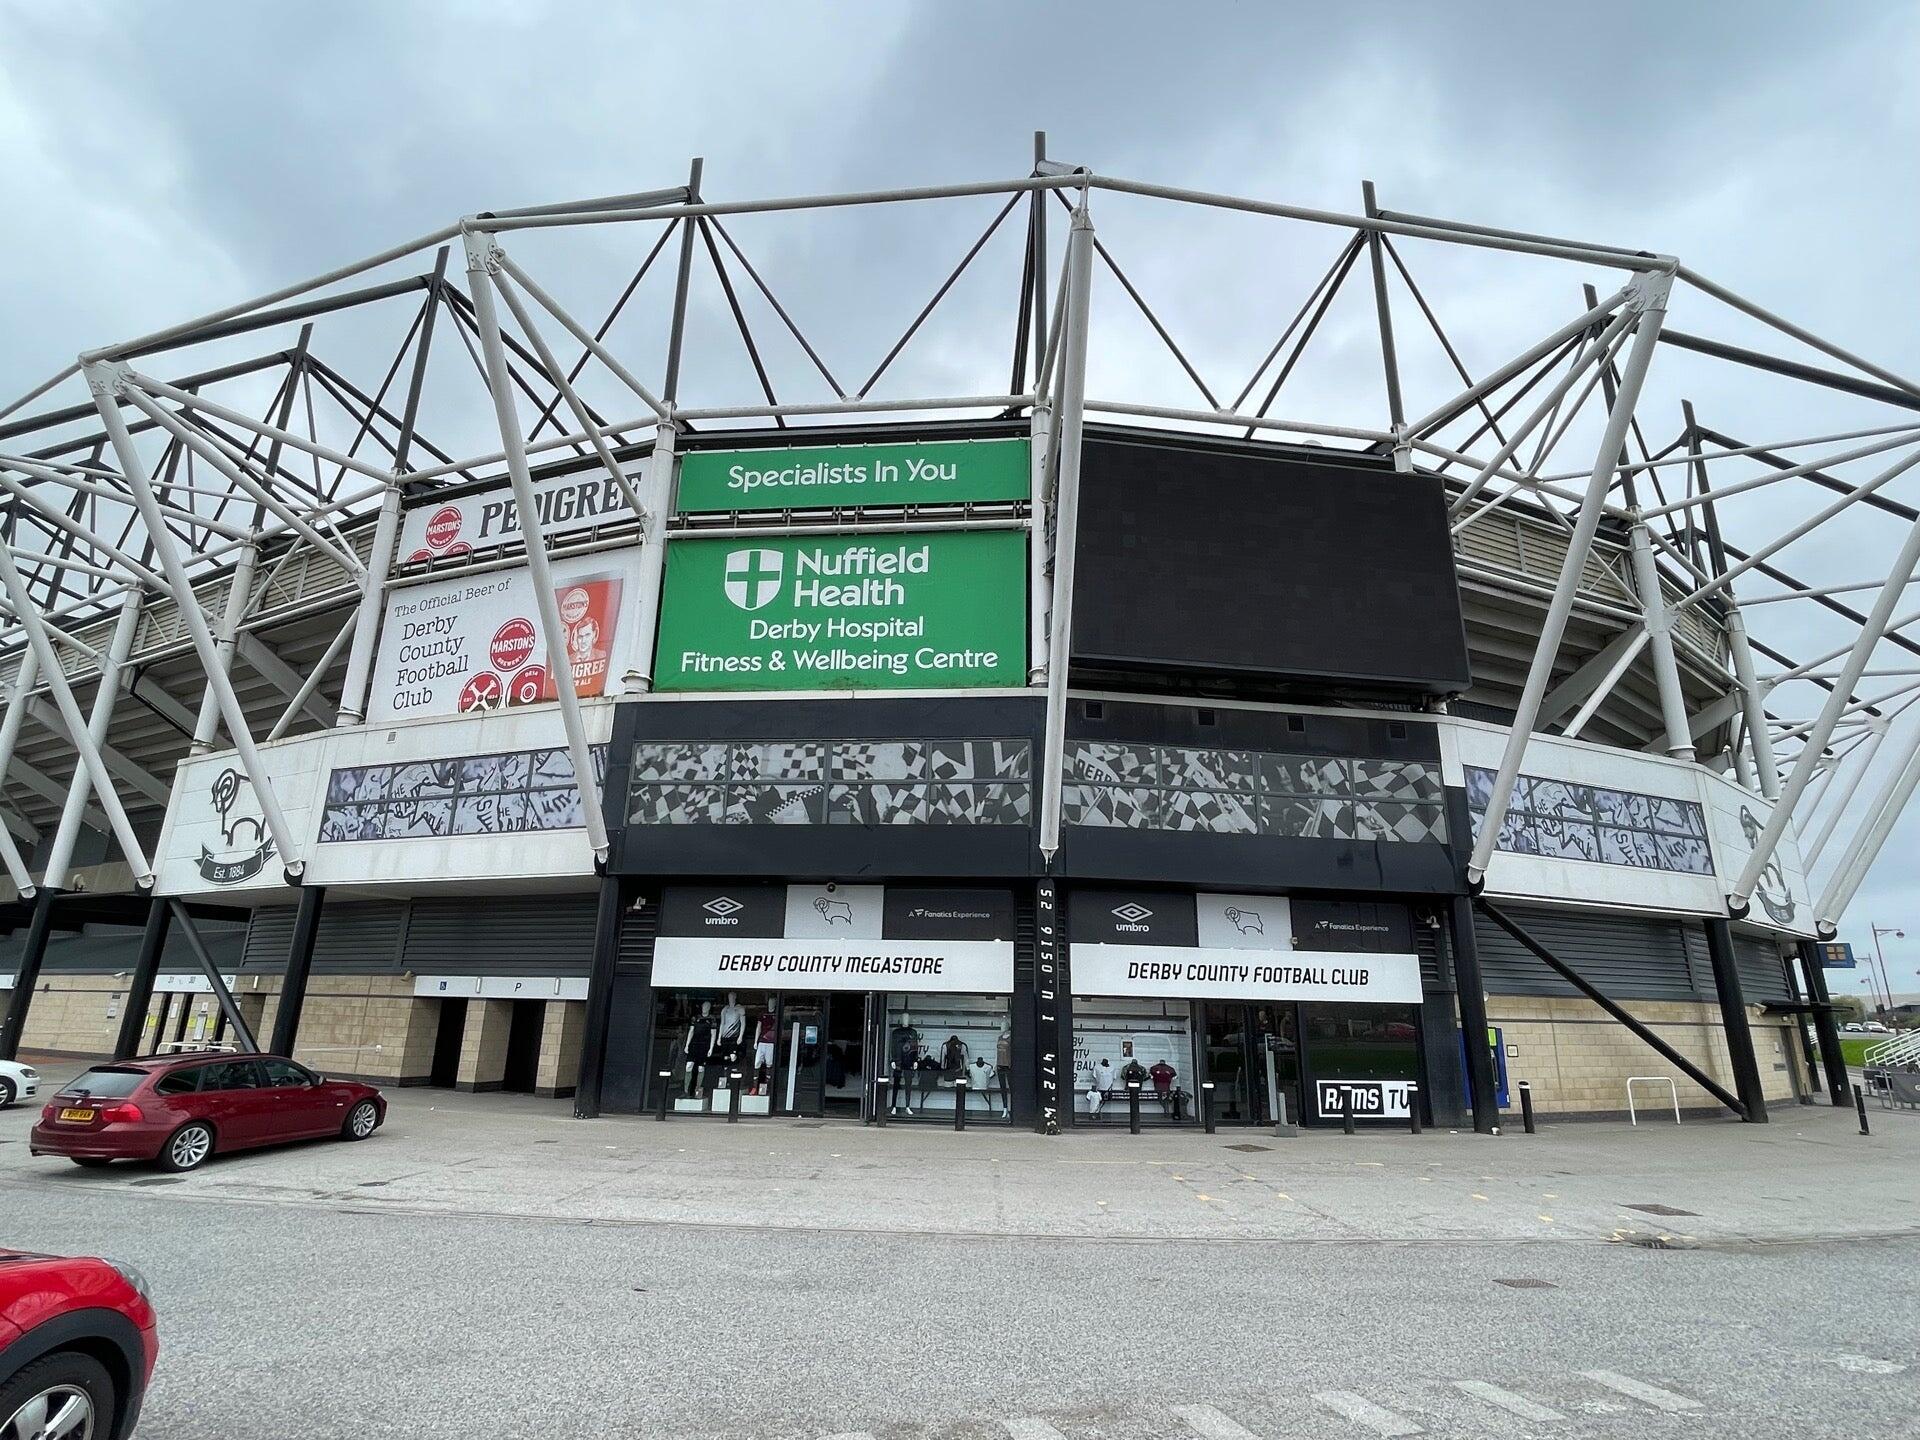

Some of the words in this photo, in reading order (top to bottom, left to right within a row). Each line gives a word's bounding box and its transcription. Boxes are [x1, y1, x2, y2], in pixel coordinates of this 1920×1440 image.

[728, 461, 867, 493] Specialists
[875, 460, 898, 482] In
[905, 458, 957, 482] You
[796, 545, 929, 577] Nuffield
[394, 604, 416, 618] The
[419, 591, 462, 612] Official
[465, 585, 495, 600] Beer
[497, 578, 511, 592] of
[794, 578, 905, 608] Health
[401, 615, 458, 641] Derby
[750, 618, 822, 643] Derby
[827, 616, 924, 643] Hospital
[399, 636, 465, 663] County
[491, 634, 535, 654] MARSTON'S
[395, 655, 469, 687] Football
[681, 651, 762, 673] Fitness
[768, 651, 786, 671] &
[793, 648, 909, 675] Wellbeing
[915, 647, 998, 669] Centre
[393, 687, 433, 711] Club
[229, 864, 245, 879] 1884
[705, 916, 739, 925] umbro
[924, 910, 952, 918] Fanatics
[952, 911, 991, 919] Experience
[1115, 922, 1150, 932] umbro
[1329, 922, 1355, 931] Fanatics
[1355, 924, 1390, 932] Experience
[718, 954, 774, 972] DERBY
[777, 955, 842, 973] COUNTY
[845, 956, 945, 974] MEGASTORE
[1127, 962, 1182, 980] DERBY
[1186, 964, 1249, 982] COUNTY
[1253, 966, 1328, 985] FOOTBALL
[1331, 968, 1370, 986] CLUB
[514, 982, 522, 992] P
[1324, 1087, 1380, 1110] RMS
